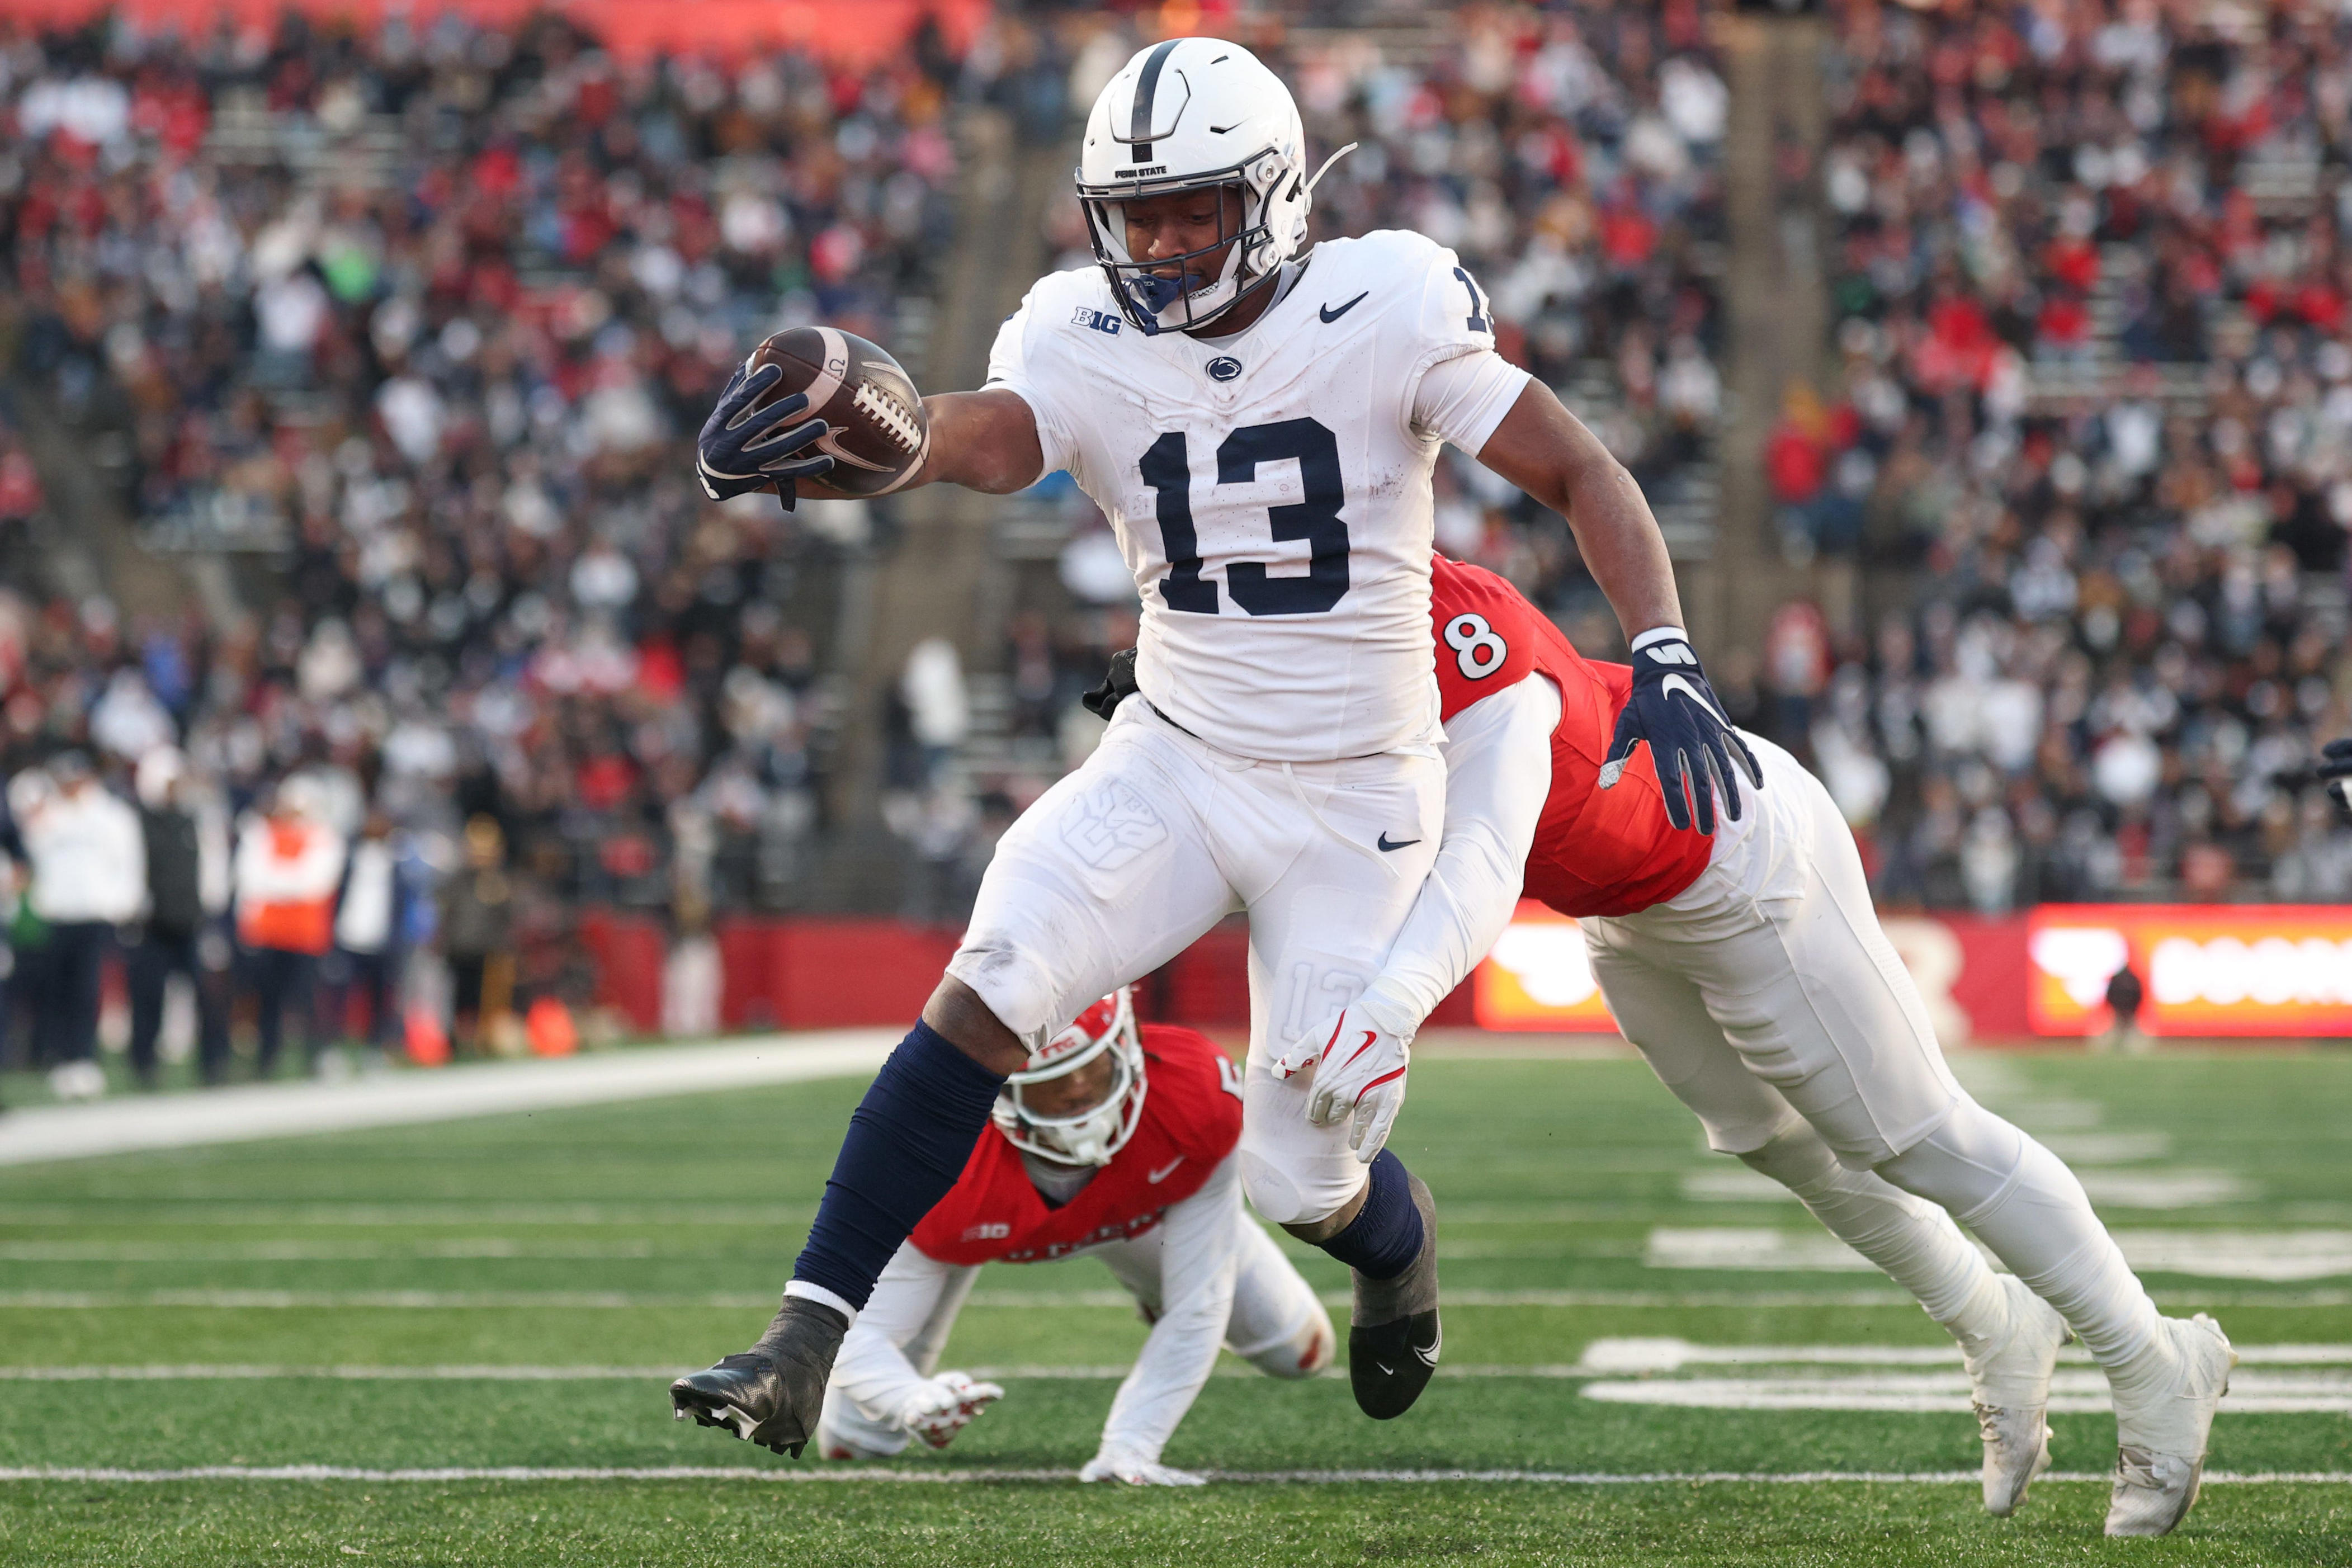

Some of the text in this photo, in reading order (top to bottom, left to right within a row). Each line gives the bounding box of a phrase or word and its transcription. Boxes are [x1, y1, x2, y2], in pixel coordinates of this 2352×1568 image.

[1115, 166, 1166, 178] PENN STATE
[1453, 267, 1494, 336] 1
[1139, 417, 1350, 616] 13
[1442, 612, 1508, 681] 8
